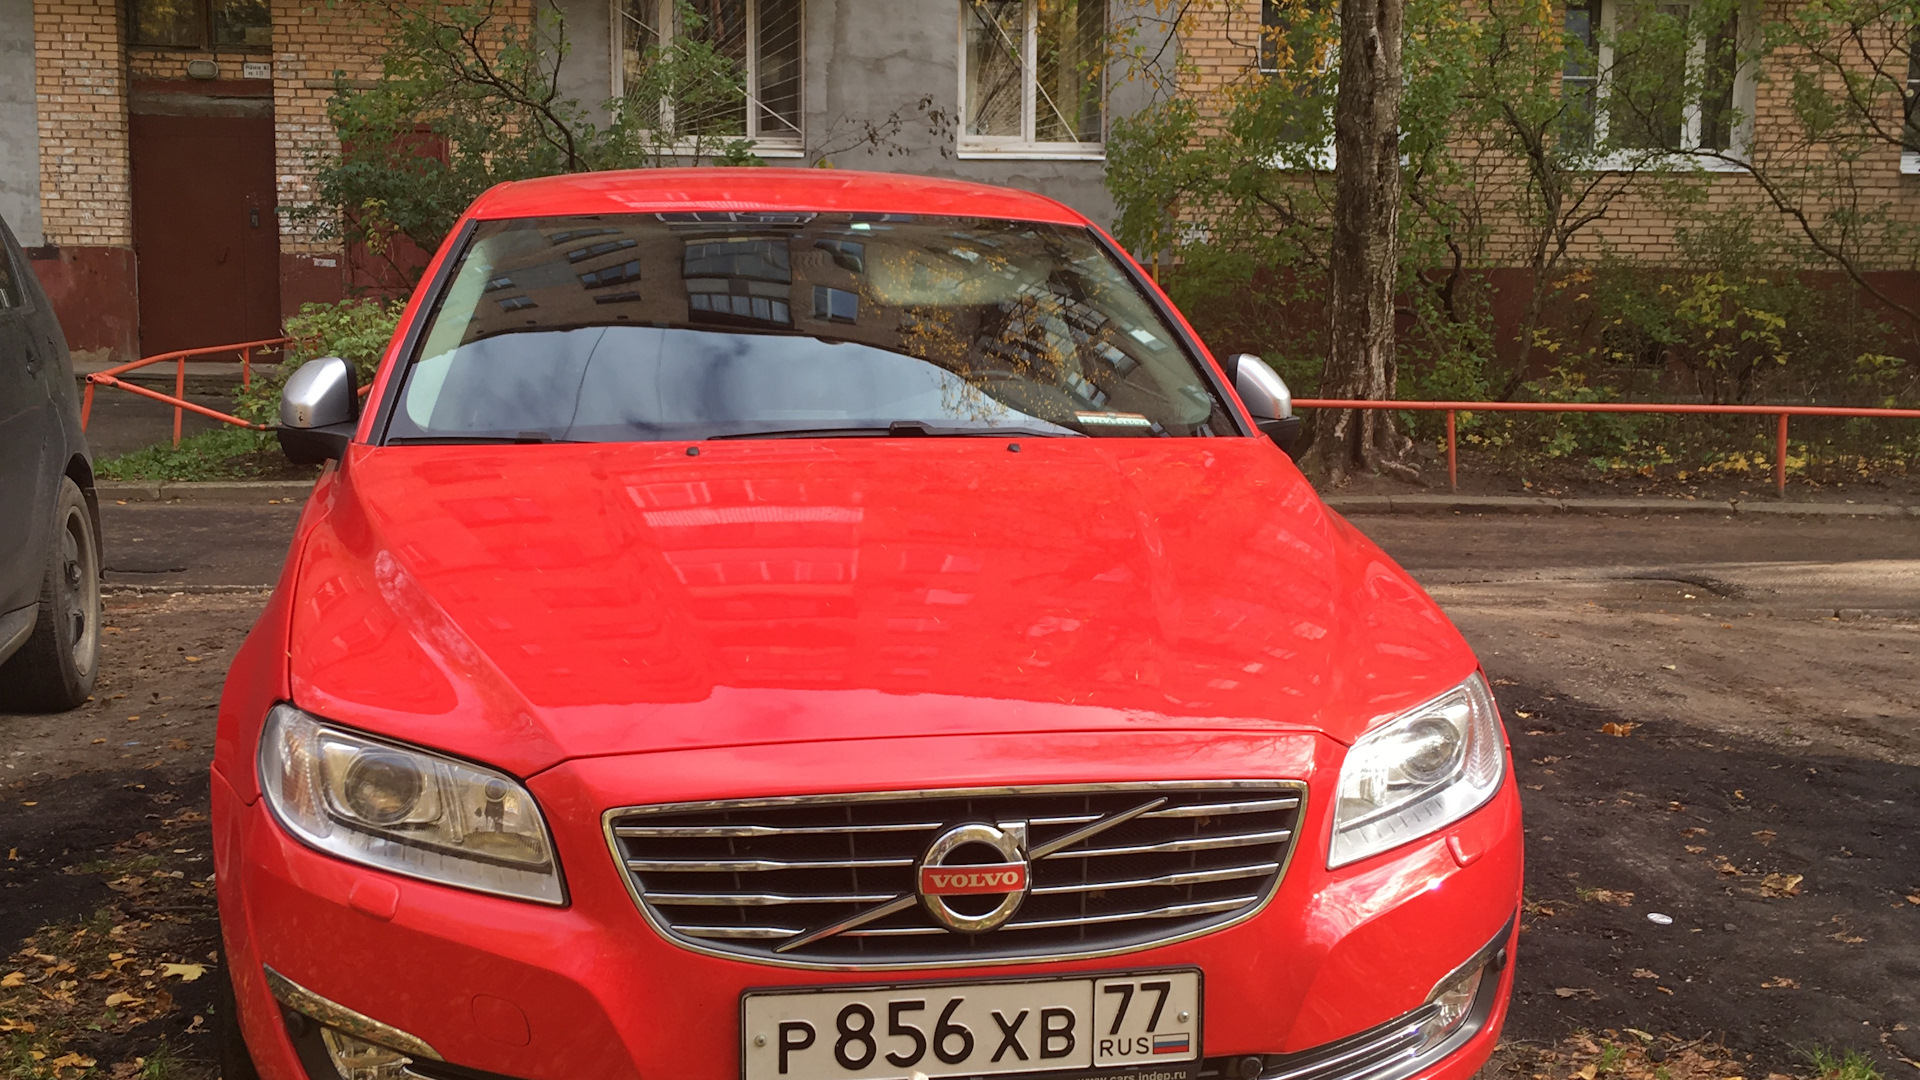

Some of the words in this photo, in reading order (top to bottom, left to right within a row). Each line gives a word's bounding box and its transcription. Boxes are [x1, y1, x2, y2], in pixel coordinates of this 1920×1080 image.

[929, 871, 1019, 888] VOLVO
[1104, 981, 1171, 1035] 77
[1100, 1037, 1150, 1058] RUS
[1077, 1070, 1187, 1080] carsindep.ru
